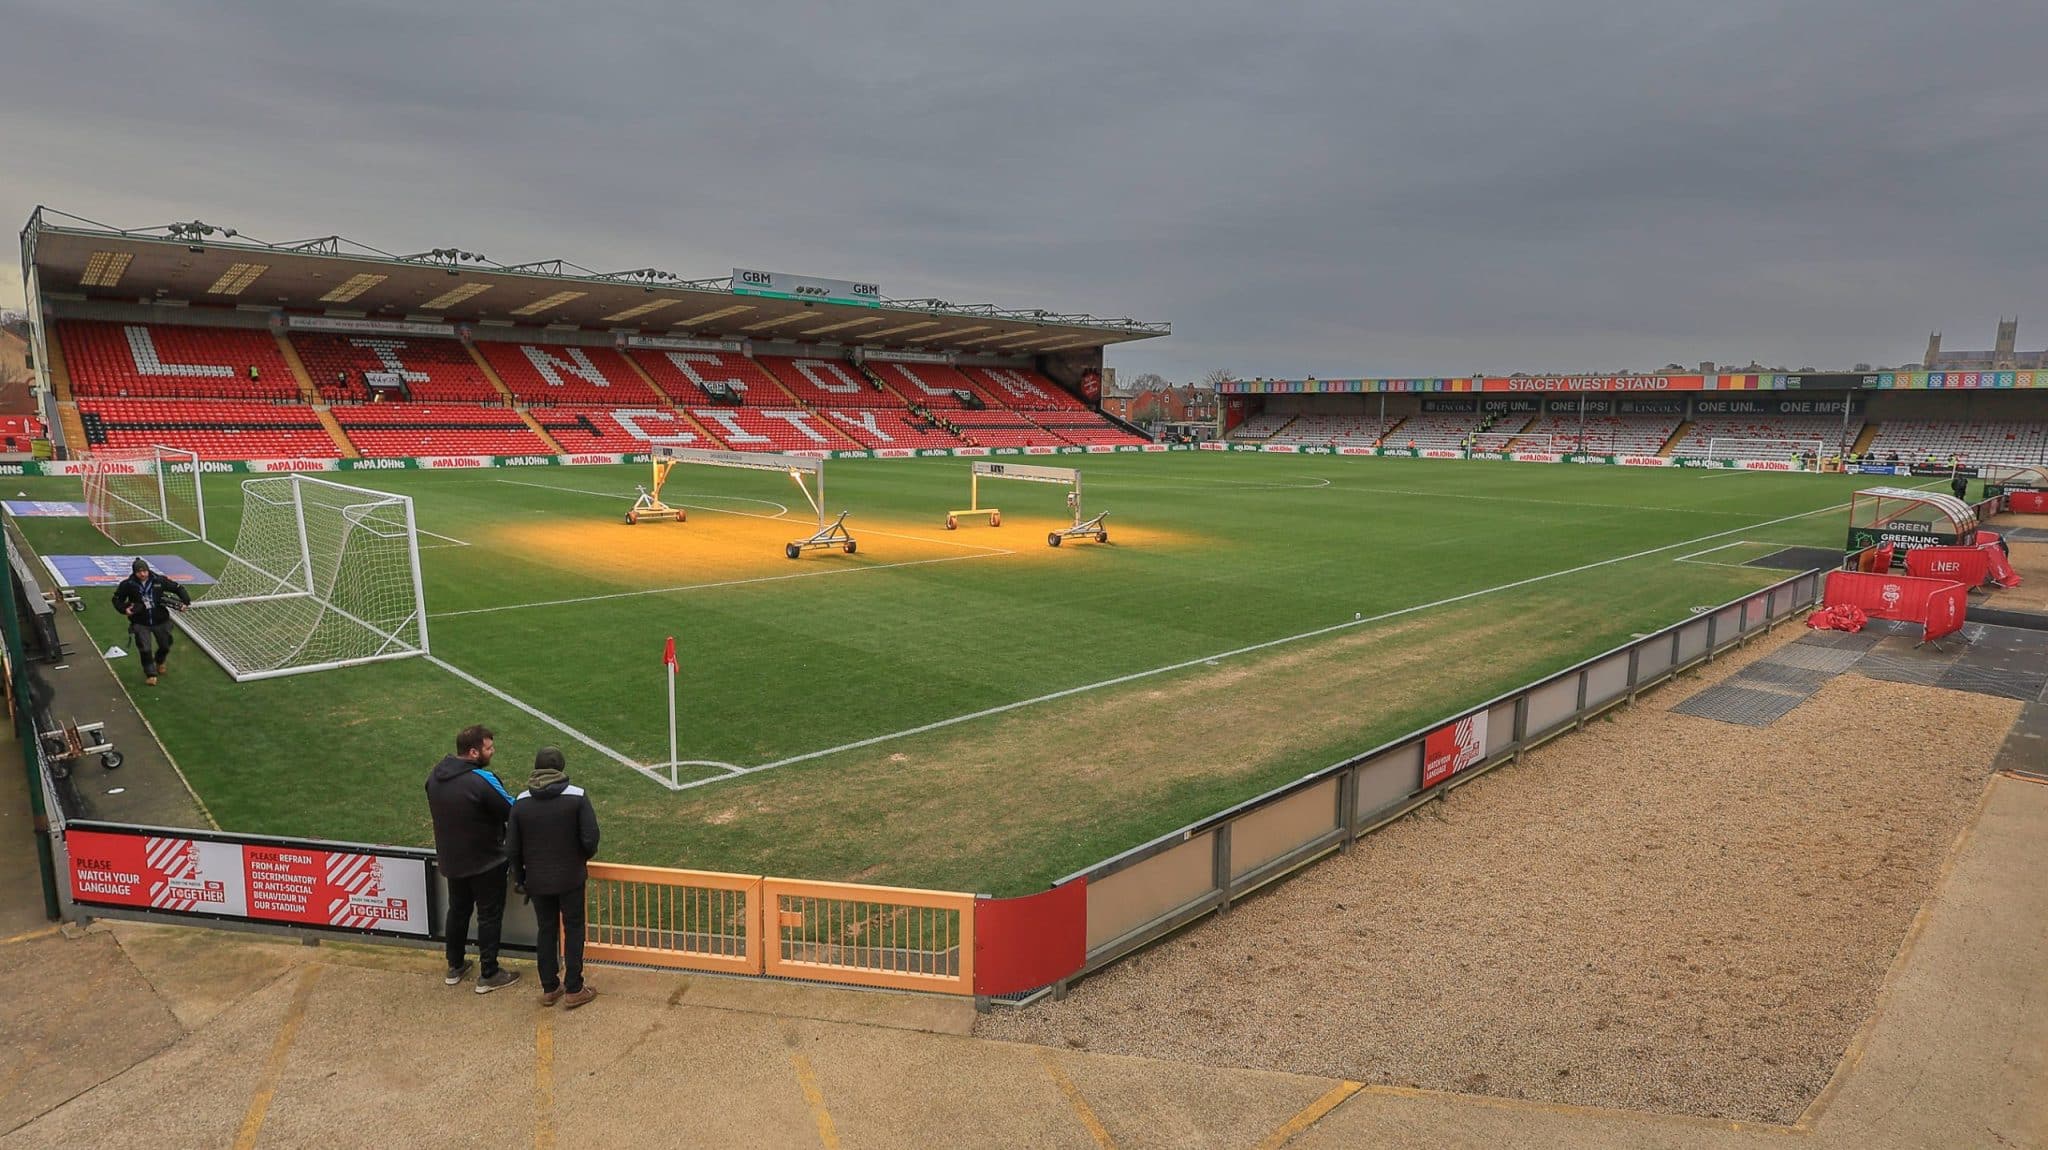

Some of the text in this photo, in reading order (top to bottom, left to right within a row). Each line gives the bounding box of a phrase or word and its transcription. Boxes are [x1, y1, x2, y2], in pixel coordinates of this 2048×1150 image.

[742, 271, 771, 284] GBM
[853, 284, 878, 295] GBM
[1508, 377, 1668, 390] STACEY WEST STAND
[1486, 401, 1507, 410] ONE
[1551, 402, 1608, 411] ONE IMPS!
[1698, 402, 1764, 412] ONE UNI...
[1780, 402, 1856, 412] ONE IMPS!
[610, 408, 895, 443] CITY
[353, 460, 405, 469] PAPA JOHNS
[432, 458, 481, 467] PAPA JOHNS
[505, 456, 549, 466] PAPA JOHNS
[589, 456, 612, 464] JOHNS
[633, 455, 648, 463] PAPA
[1625, 457, 1663, 466] PAPA JOHNS
[267, 460, 324, 471] PAPA JOHNS
[1746, 460, 1789, 470] PAPA JOHNS
[1889, 522, 1929, 532] GREEN
[1880, 533, 1939, 545] GREENLINC
[1930, 561, 1960, 572] LNER
[250, 852, 312, 864] PLEASE REFRAIN
[76, 858, 112, 870] PLEASE
[251, 861, 290, 872] FROM ANY
[77, 869, 140, 884] WATCH YOUR
[252, 871, 317, 885] DISCRIMINATORY
[79, 881, 131, 895] LANGUAGE
[253, 881, 313, 895] OR ANTI-SOCIAL
[170, 888, 224, 902] TOGETHER
[253, 890, 307, 904] BEHAVIOUR IN
[254, 901, 306, 913] OUR STADIUM
[351, 905, 407, 920] TOGETHER
